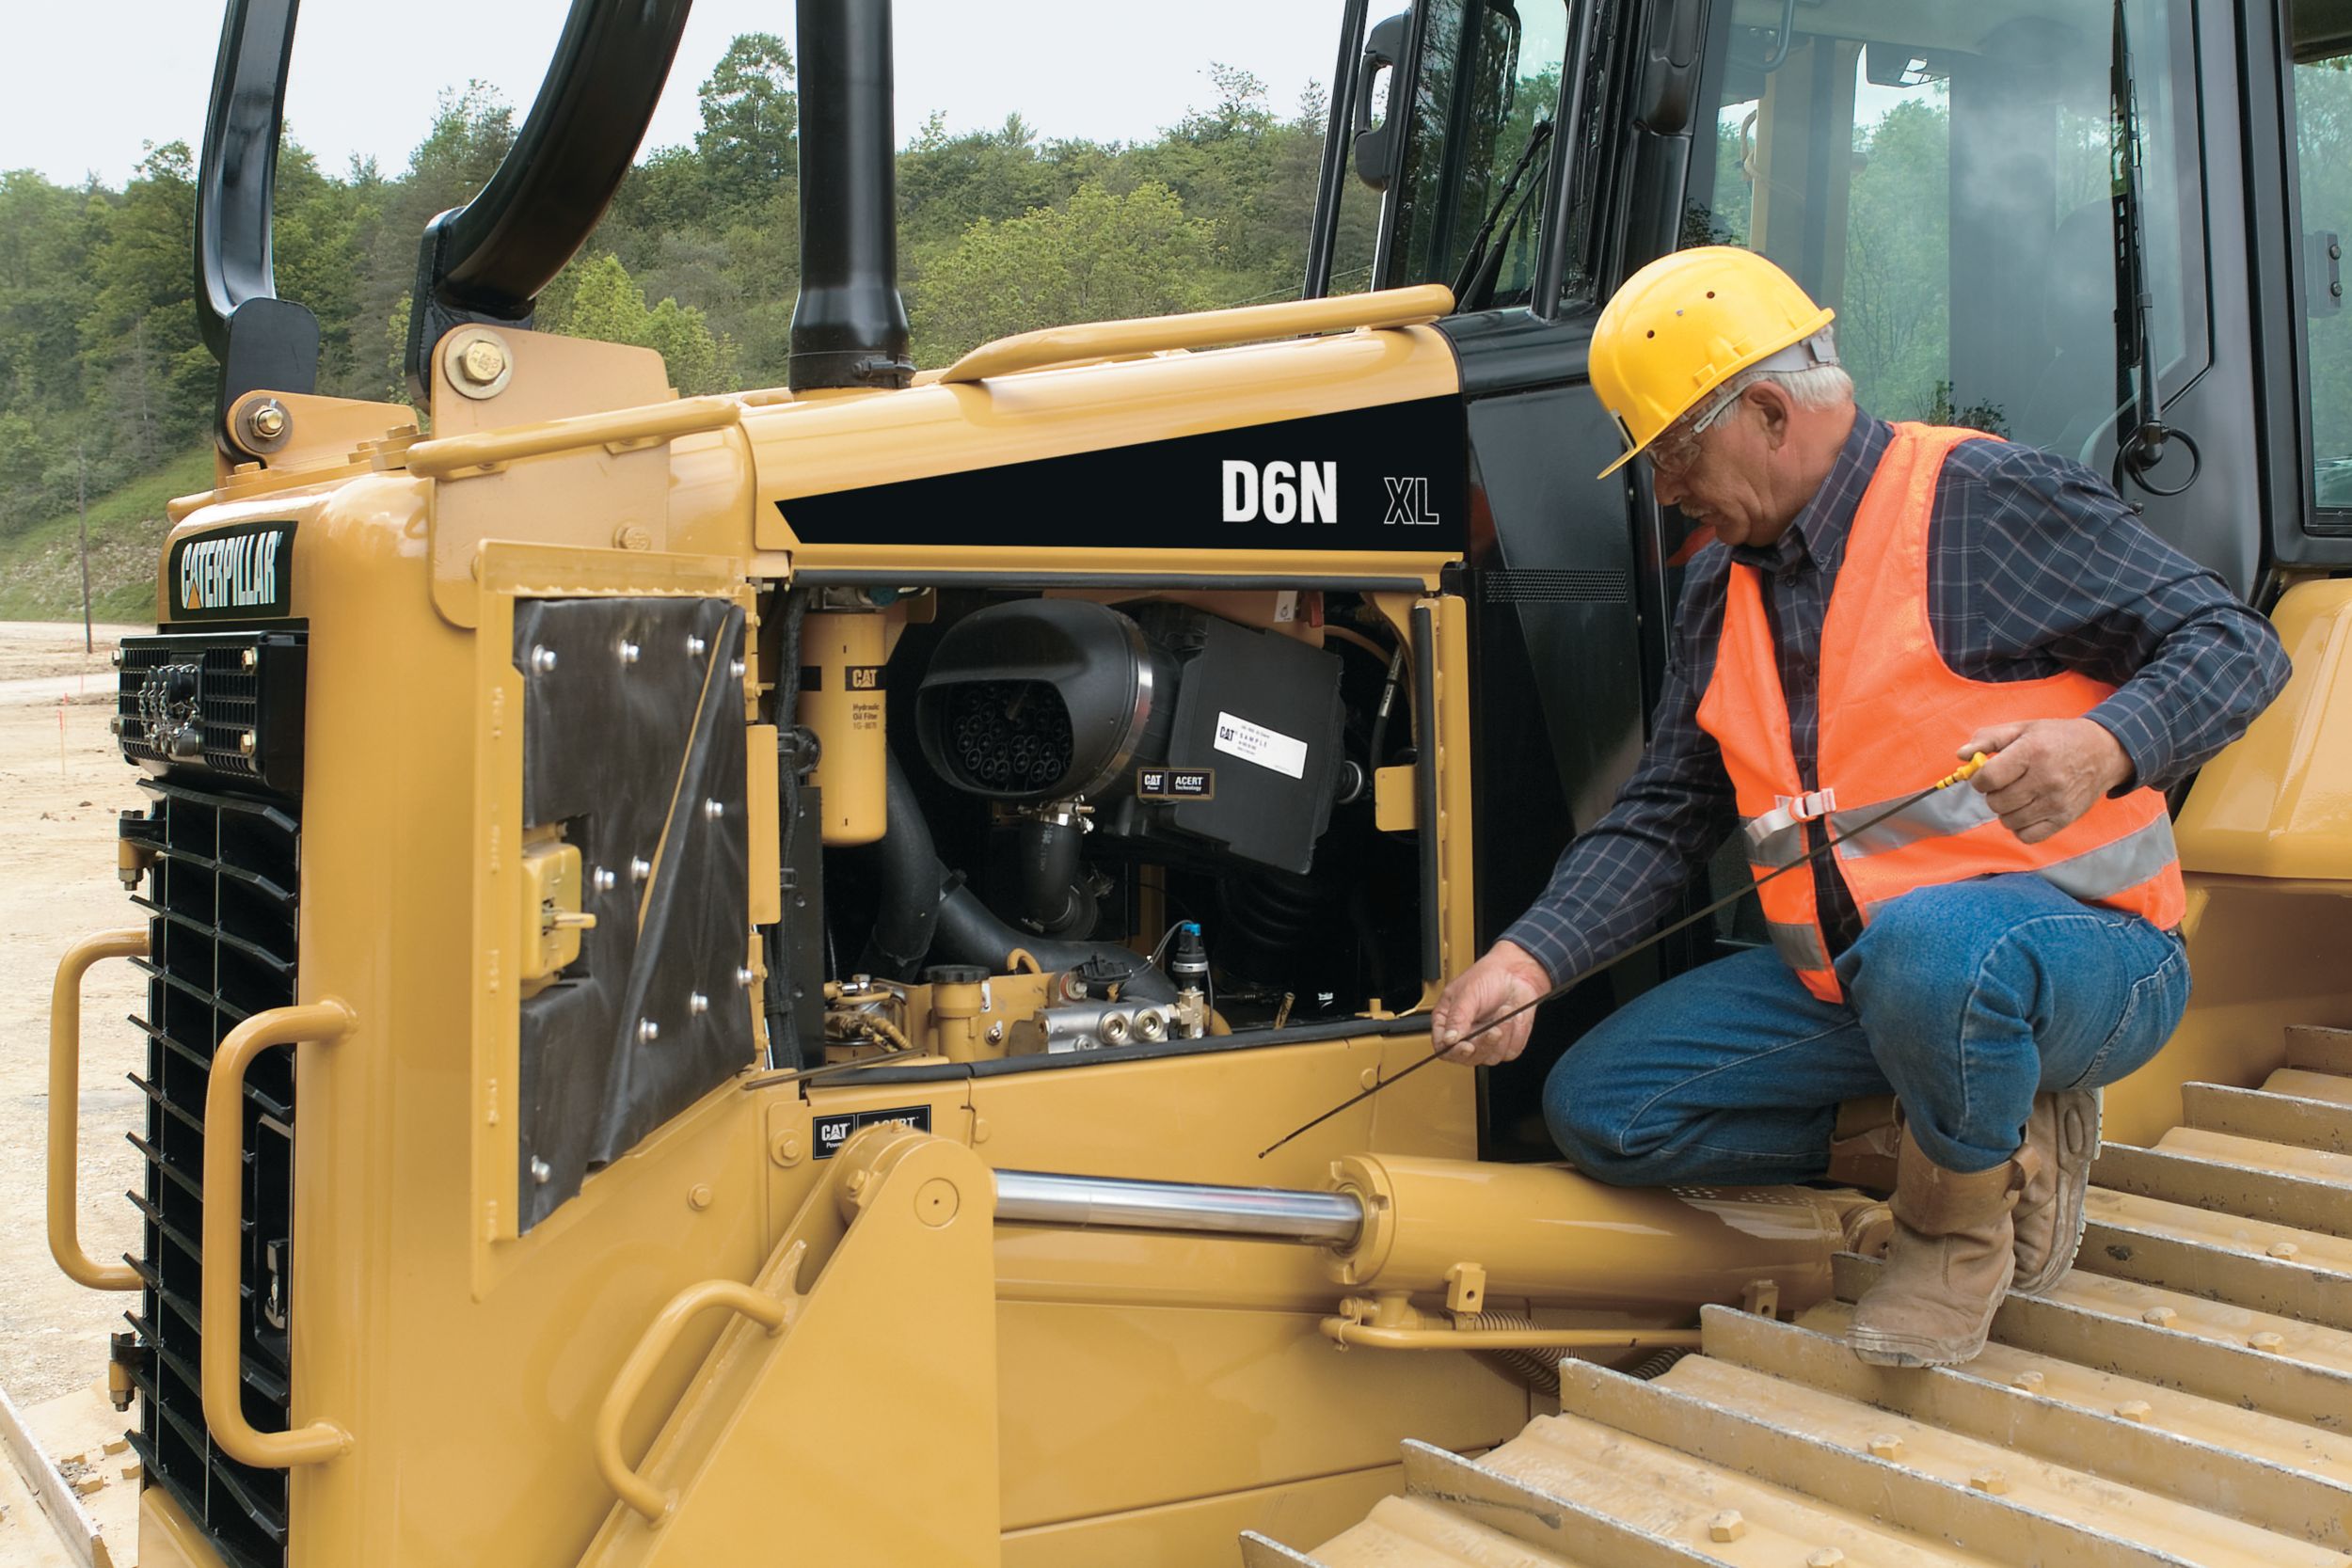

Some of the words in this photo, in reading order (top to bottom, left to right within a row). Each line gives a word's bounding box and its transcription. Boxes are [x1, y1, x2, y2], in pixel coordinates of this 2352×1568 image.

[1222, 459, 1338, 525] D6N
[1384, 477, 1439, 525] XL
[181, 531, 278, 610] CATERPILLAR
[852, 669, 877, 688] CAT
[1219, 726, 1235, 741] CAT
[1239, 732, 1267, 748] SAMPLE
[1144, 774, 1162, 785] CAT
[1175, 776, 1203, 785] ACERT
[821, 1123, 849, 1141] CAT
